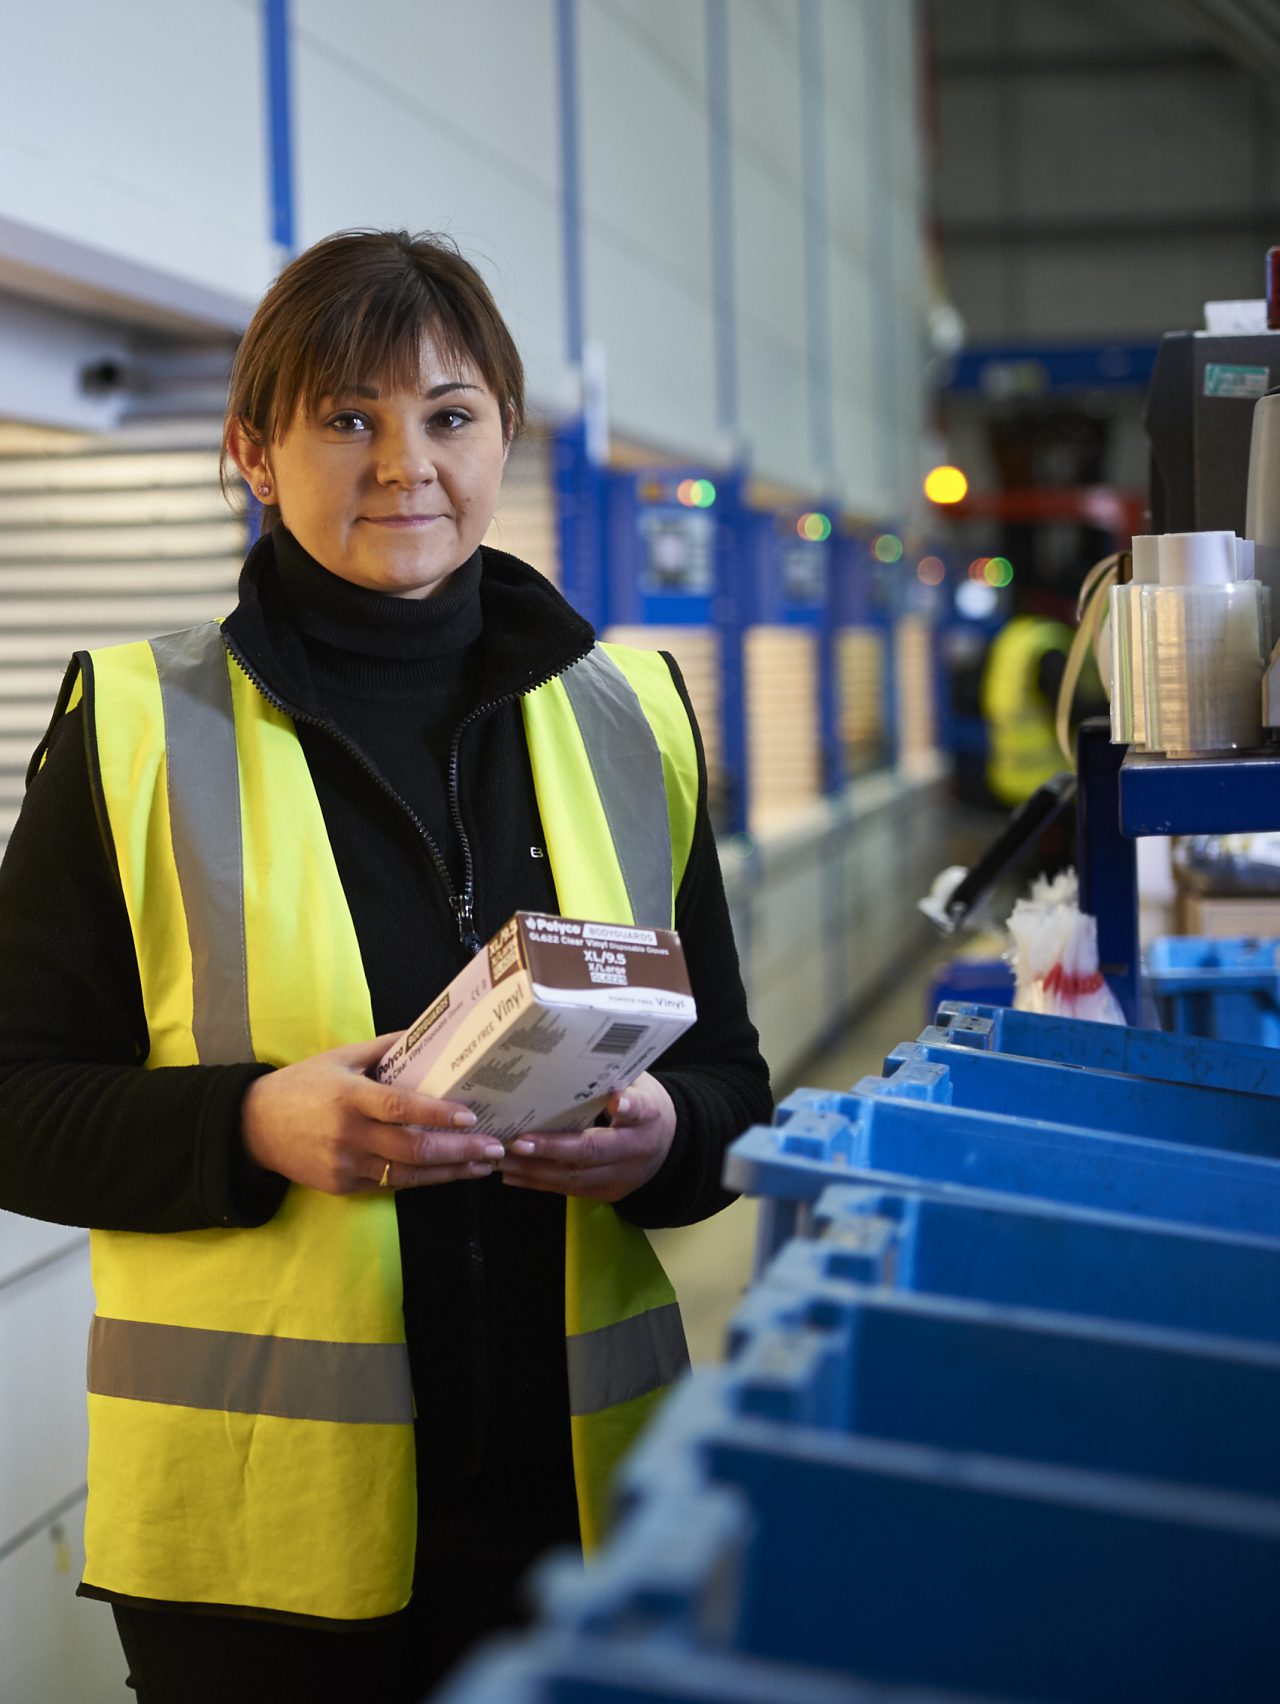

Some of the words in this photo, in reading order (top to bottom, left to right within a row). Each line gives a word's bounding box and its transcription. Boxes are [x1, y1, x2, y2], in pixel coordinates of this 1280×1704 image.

[536, 918, 582, 935] Polyco
[588, 926, 654, 943] BODYGUARDS
[561, 935, 584, 947] Clear
[585, 938, 608, 950] Vinyl
[583, 949, 627, 966] XL/9.5
[588, 962, 626, 976] X/Large
[655, 997, 685, 1010] Vinyl
[451, 1039, 478, 1072] POWDER
[477, 1021, 496, 1044] FREE
[492, 983, 525, 1023] Vinyl
[378, 1045, 404, 1076] Polyco
